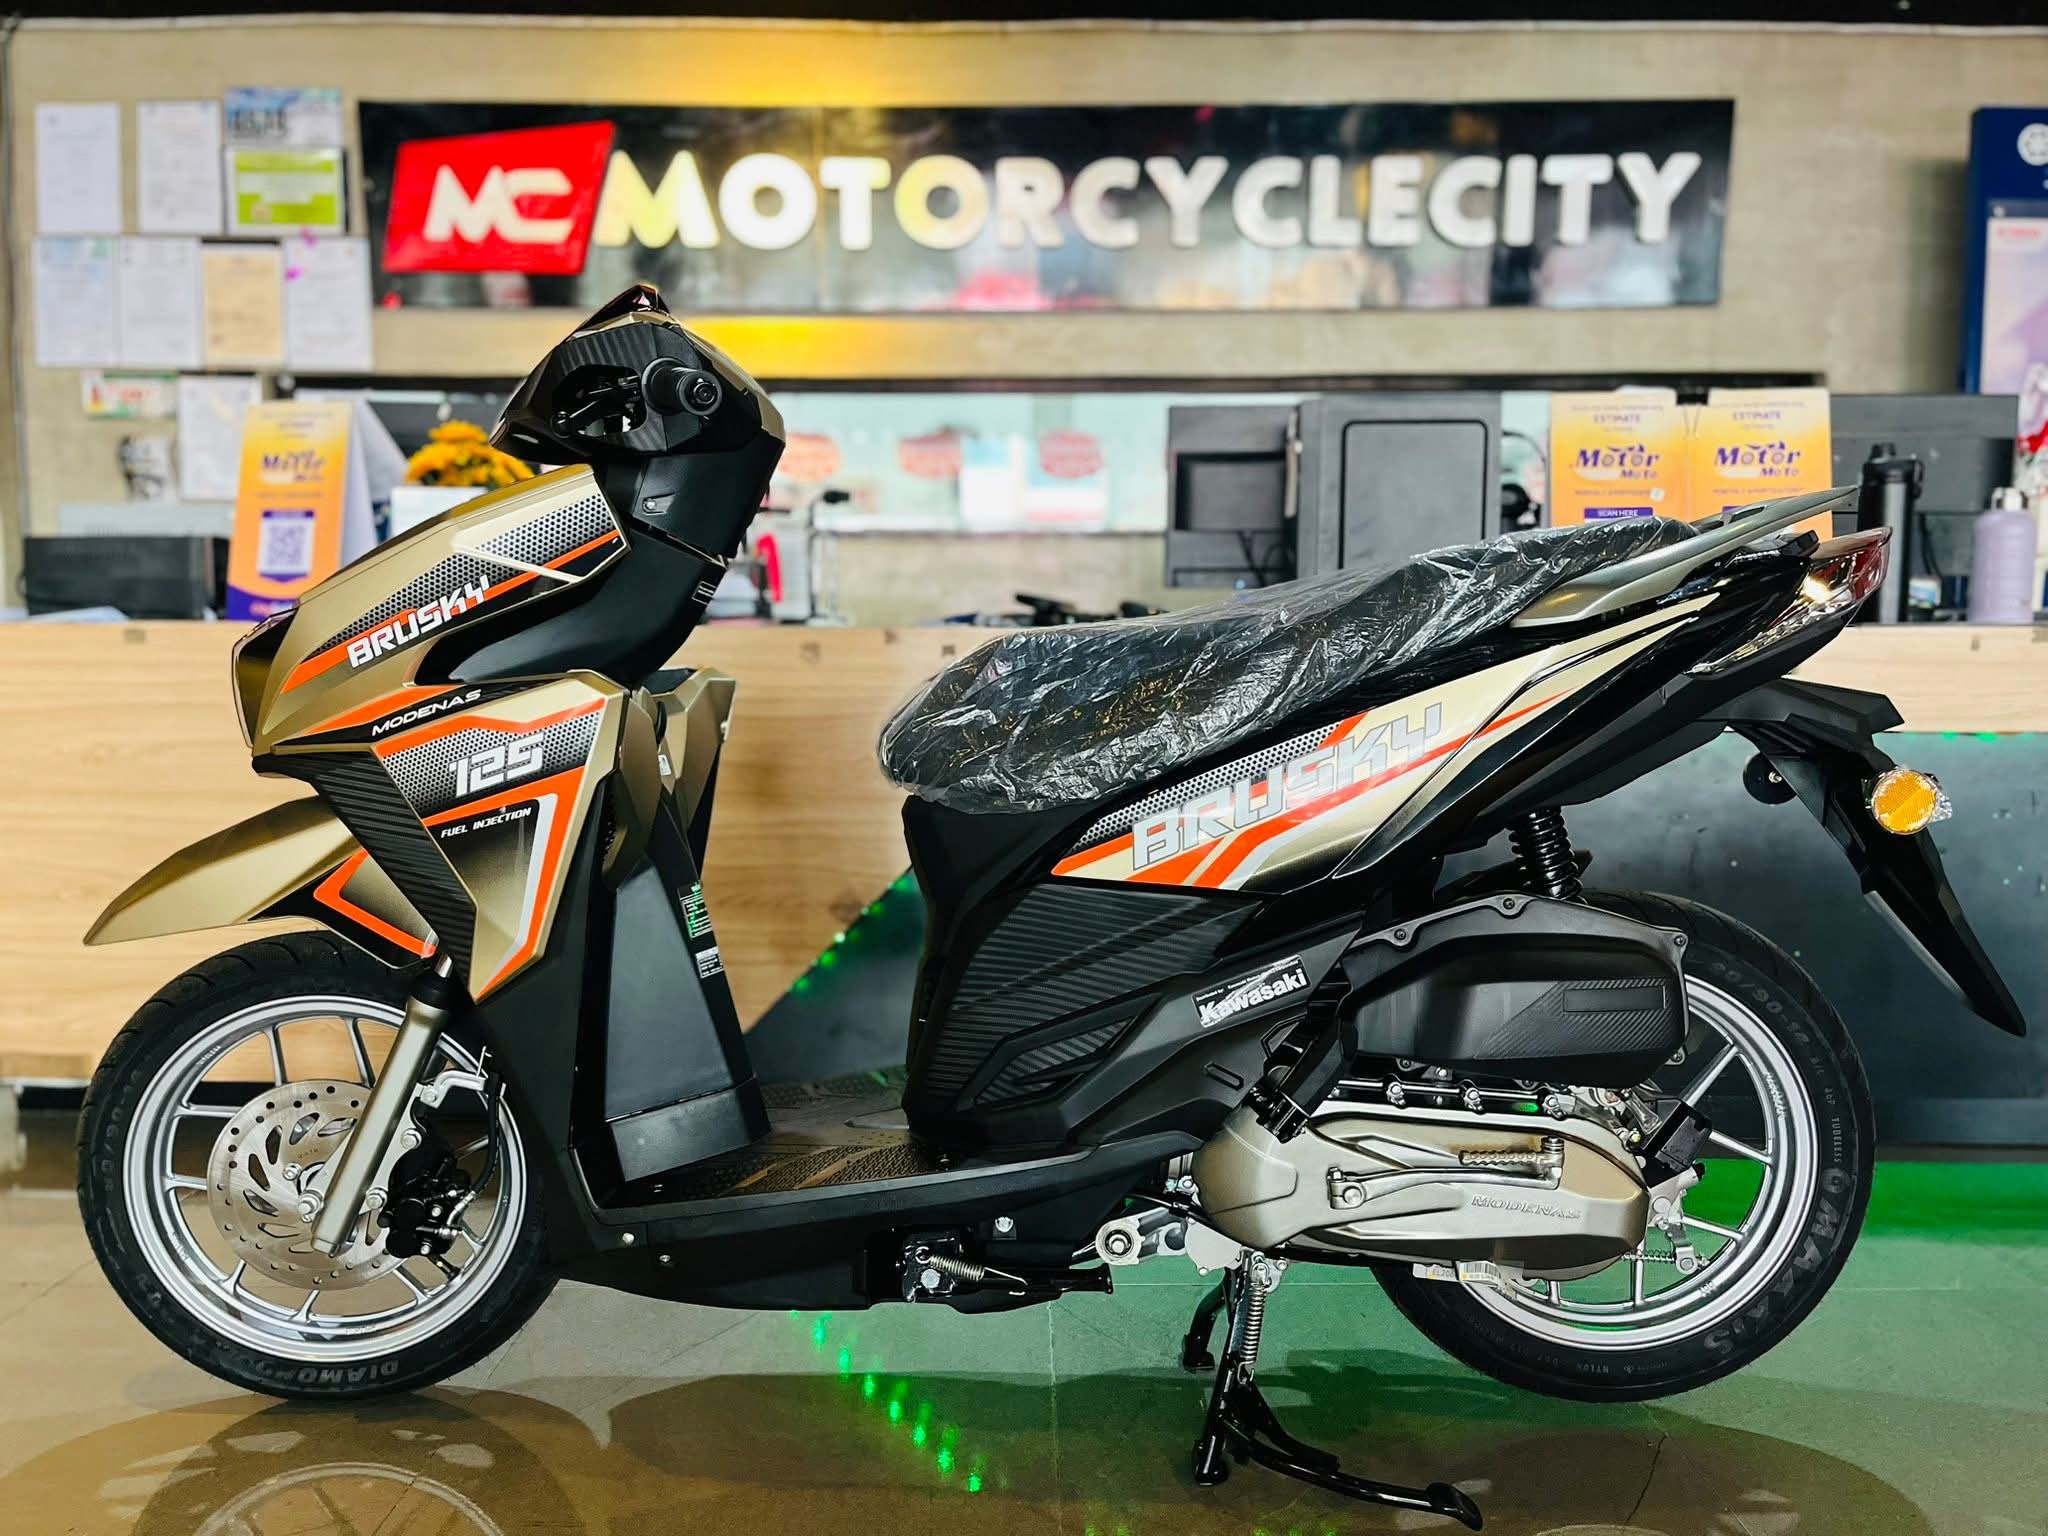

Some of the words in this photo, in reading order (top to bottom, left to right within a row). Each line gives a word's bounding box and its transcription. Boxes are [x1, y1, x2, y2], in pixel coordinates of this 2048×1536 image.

[423, 165, 574, 244] MC
[596, 149, 1701, 250] MOTORCYCLECITY
[1578, 446, 1659, 467] Motor
[1715, 444, 1800, 466] Motor
[346, 575, 490, 669] BRUSKY
[371, 689, 482, 737] MODENAS
[448, 731, 545, 799] 125
[1132, 702, 1442, 871] BRUSKY
[441, 824, 468, 839] FUEL
[472, 807, 532, 830] INJECTION
[1199, 968, 1307, 1021] Kawasaki
[1471, 1195, 1581, 1219] MODENAS
